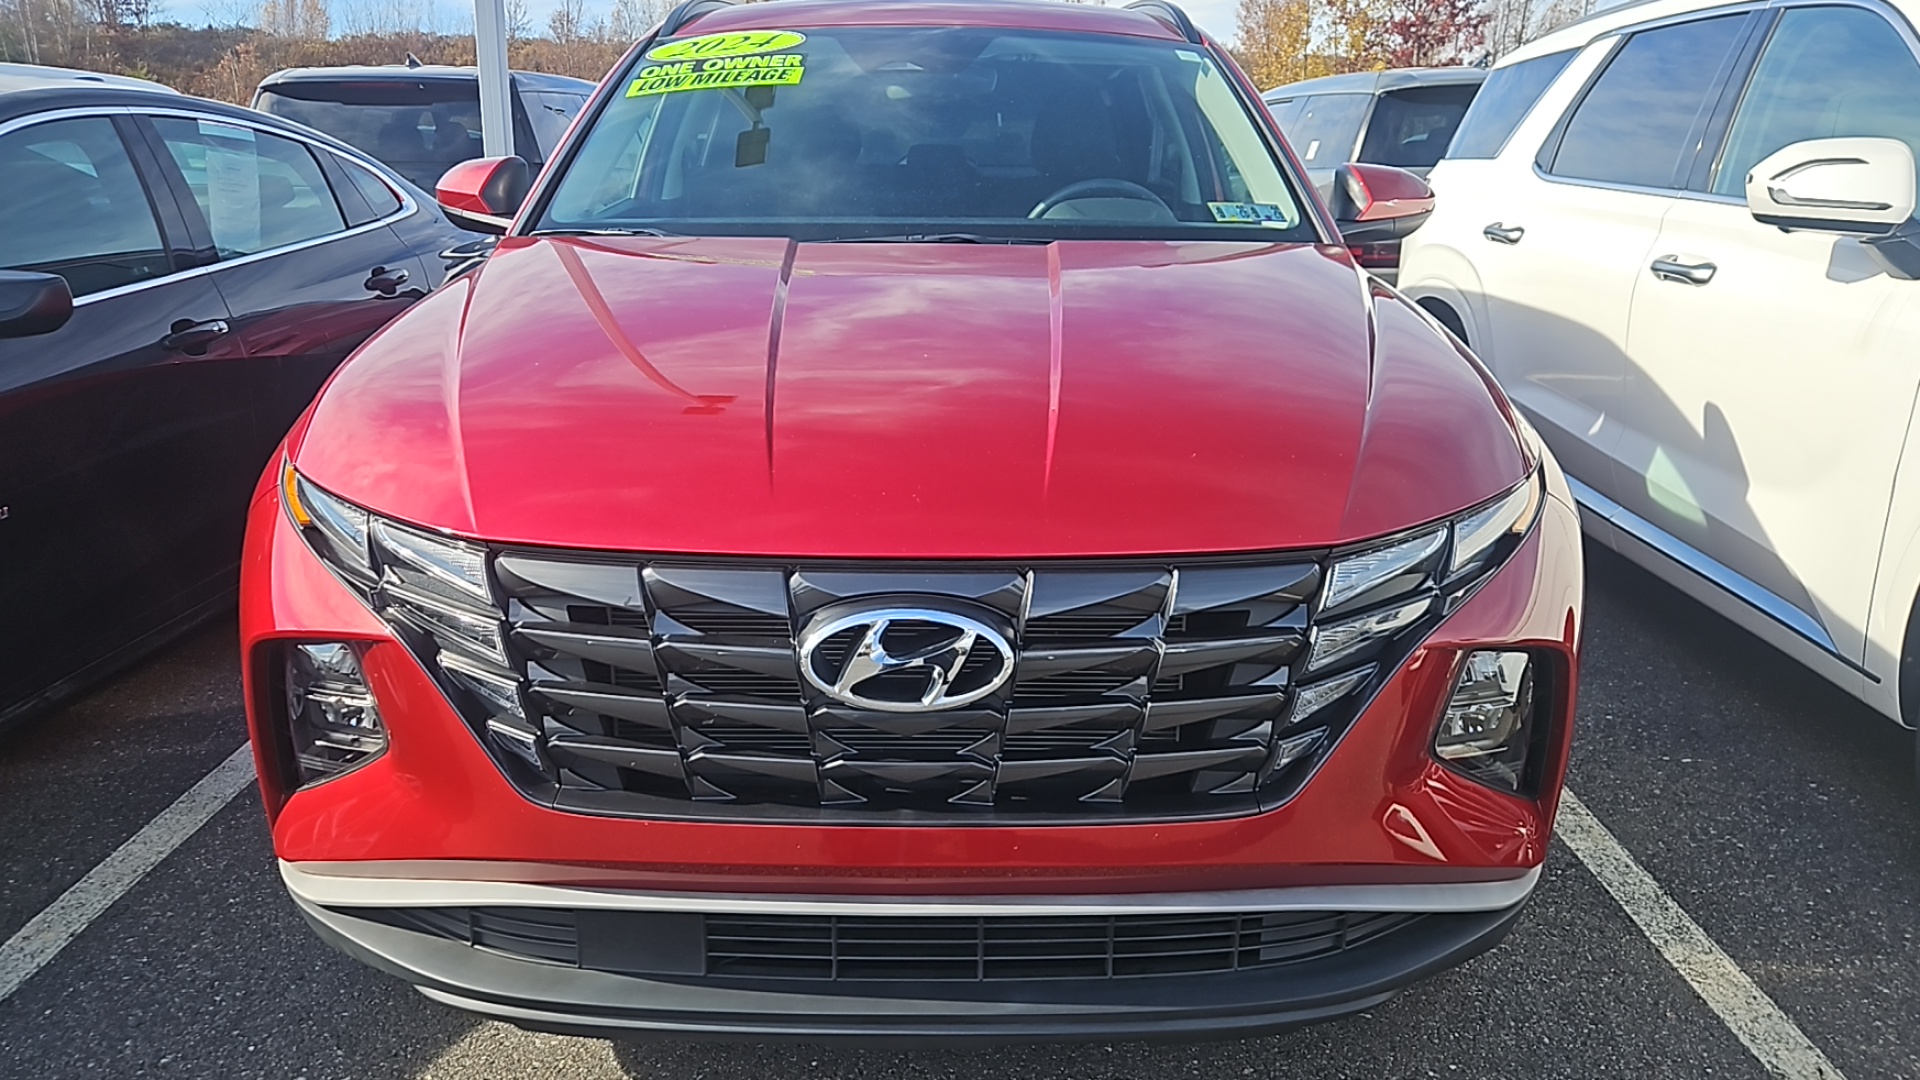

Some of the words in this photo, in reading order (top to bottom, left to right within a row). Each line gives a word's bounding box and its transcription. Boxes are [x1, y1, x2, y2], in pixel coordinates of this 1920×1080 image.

[667, 33, 783, 57] 2024
[639, 61, 697, 78] ONE
[702, 54, 803, 71] OWNER
[636, 74, 688, 93] LOW
[690, 69, 792, 86] MILEAGE
